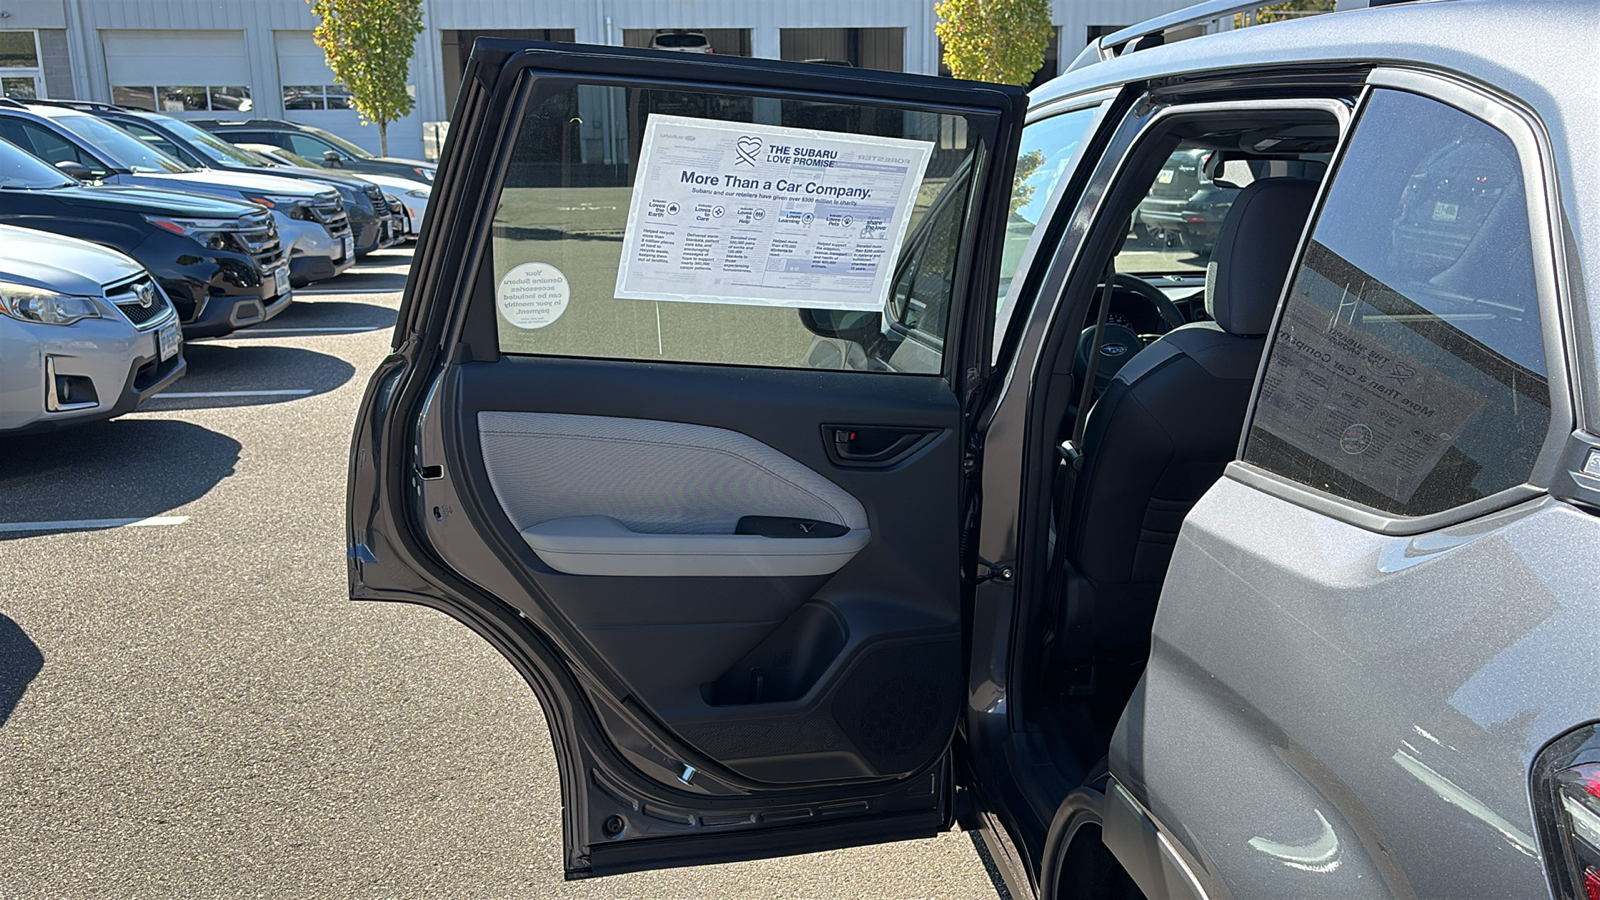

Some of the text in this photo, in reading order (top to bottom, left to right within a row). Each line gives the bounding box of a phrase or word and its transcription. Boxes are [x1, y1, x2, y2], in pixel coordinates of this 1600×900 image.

[770, 145, 838, 160] THE SUBARU
[767, 155, 835, 168] LOVE PROMISE
[681, 171, 871, 200] More Than a Car Company.
